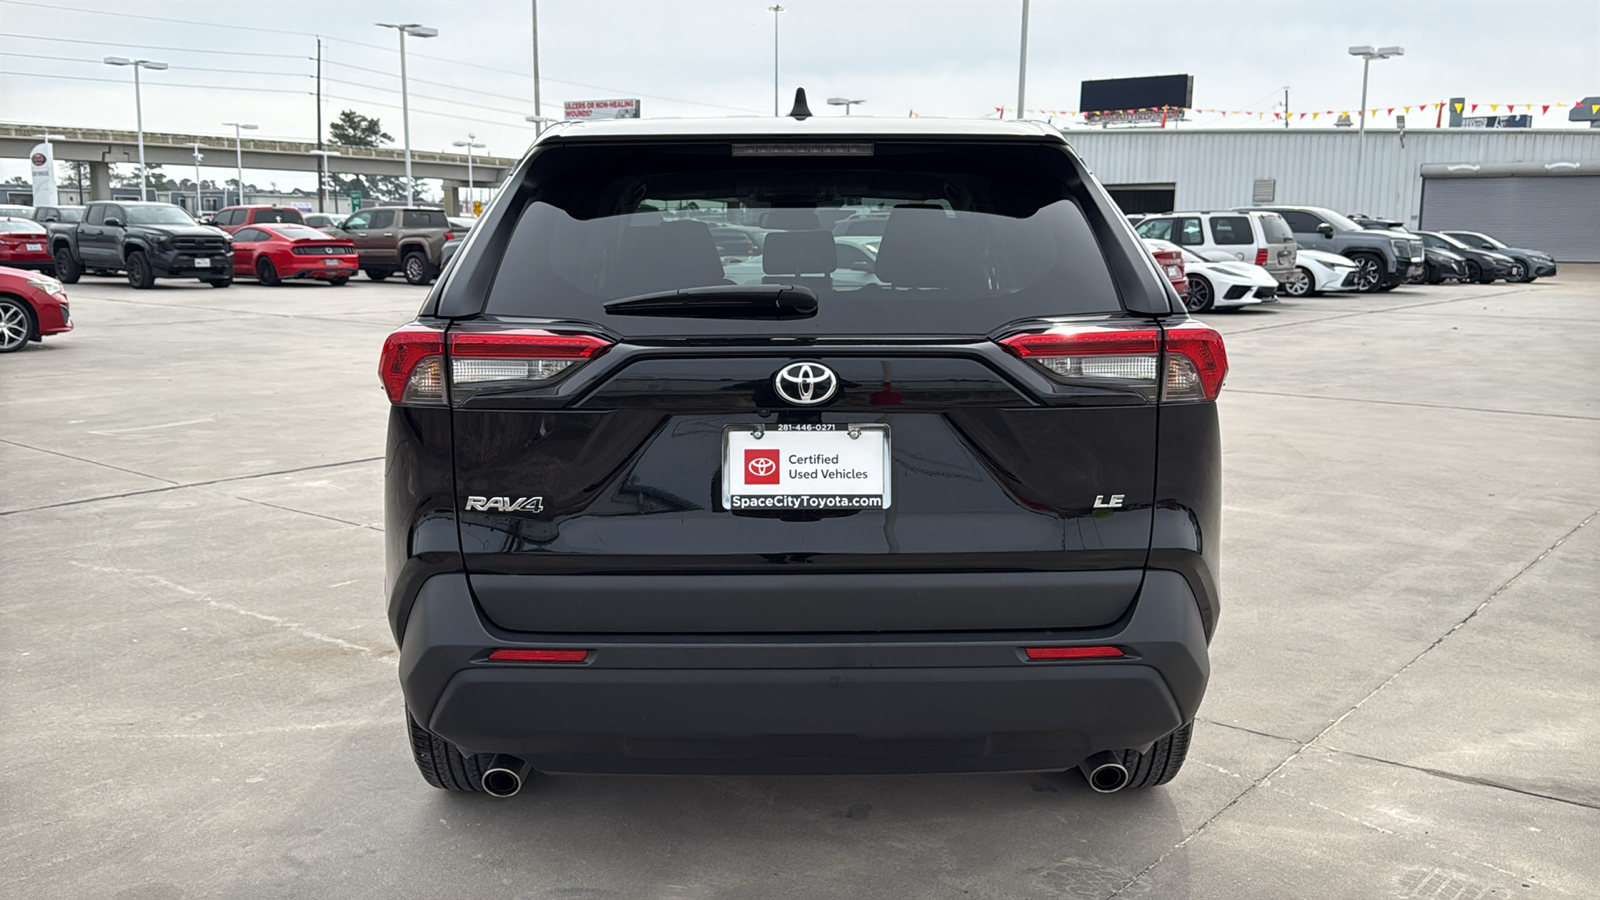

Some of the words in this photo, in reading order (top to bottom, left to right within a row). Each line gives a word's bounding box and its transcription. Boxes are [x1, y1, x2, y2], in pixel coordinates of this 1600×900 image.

[778, 423, 836, 431] 281-446-0271
[788, 454, 839, 465] Certified
[788, 468, 818, 479] Used
[821, 468, 868, 479] Vehicles
[465, 496, 544, 514] RAV4
[732, 495, 882, 508] SpaceCityToyota.com
[1093, 494, 1125, 508] LE
